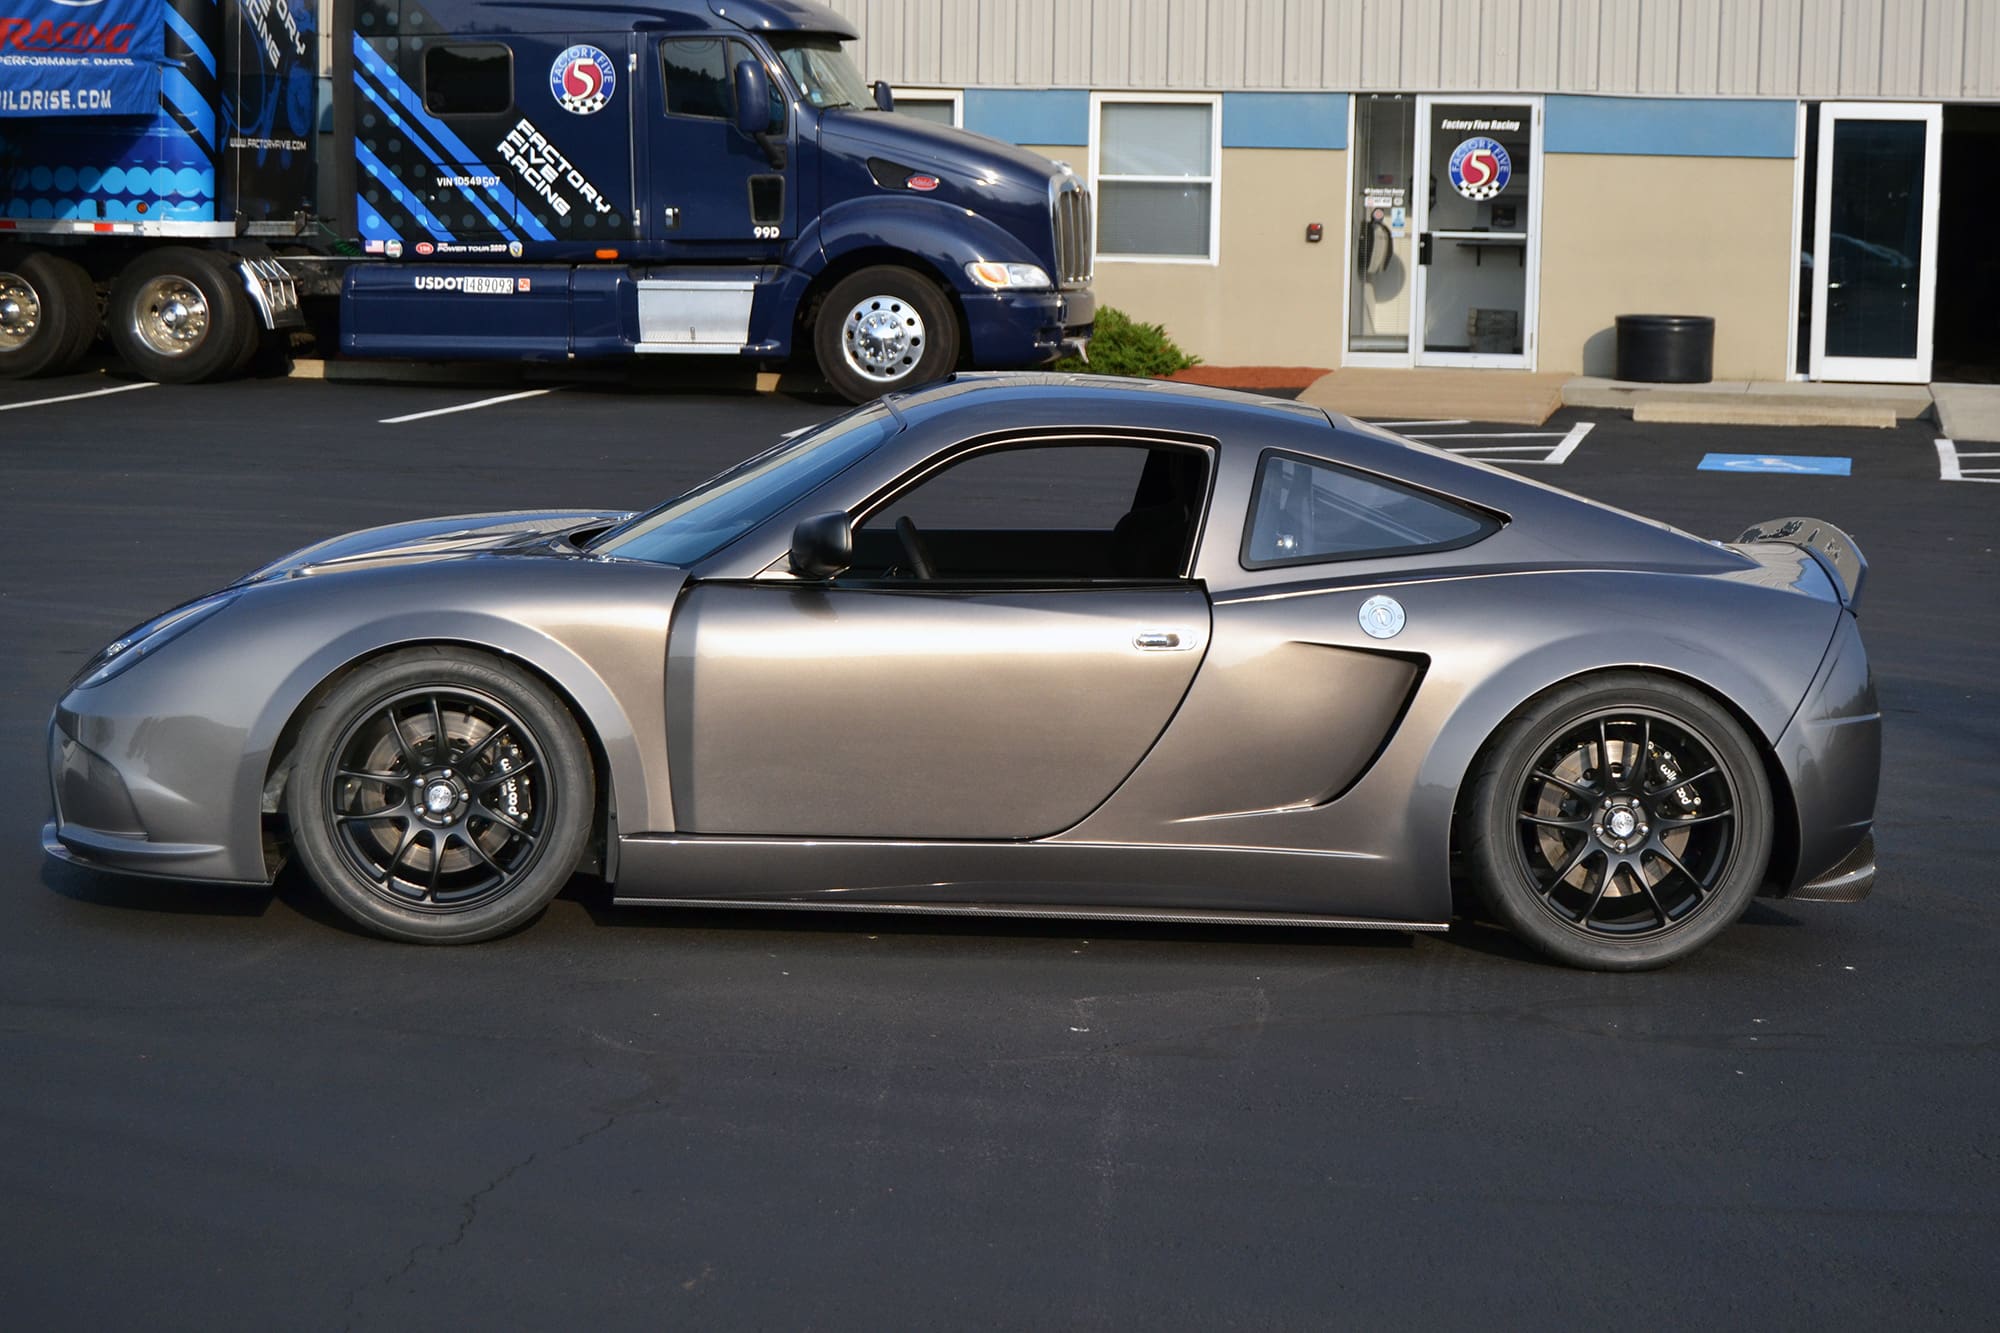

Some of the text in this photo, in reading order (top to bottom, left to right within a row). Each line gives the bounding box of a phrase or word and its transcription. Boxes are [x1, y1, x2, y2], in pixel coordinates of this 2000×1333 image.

[573, 58, 594, 100] 5
[597, 56, 614, 83] FIVE
[0, 89, 112, 110] ILDRISE.COM
[1441, 119, 1520, 132] Factory Five Racing
[506, 129, 559, 183] FIVE
[515, 118, 611, 213] FACTORY
[1468, 149, 1491, 187] 5
[1493, 148, 1509, 172] FIVE
[496, 140, 571, 217] RACING
[753, 226, 780, 239] 99D
[415, 276, 513, 294] USDOT 1489093
